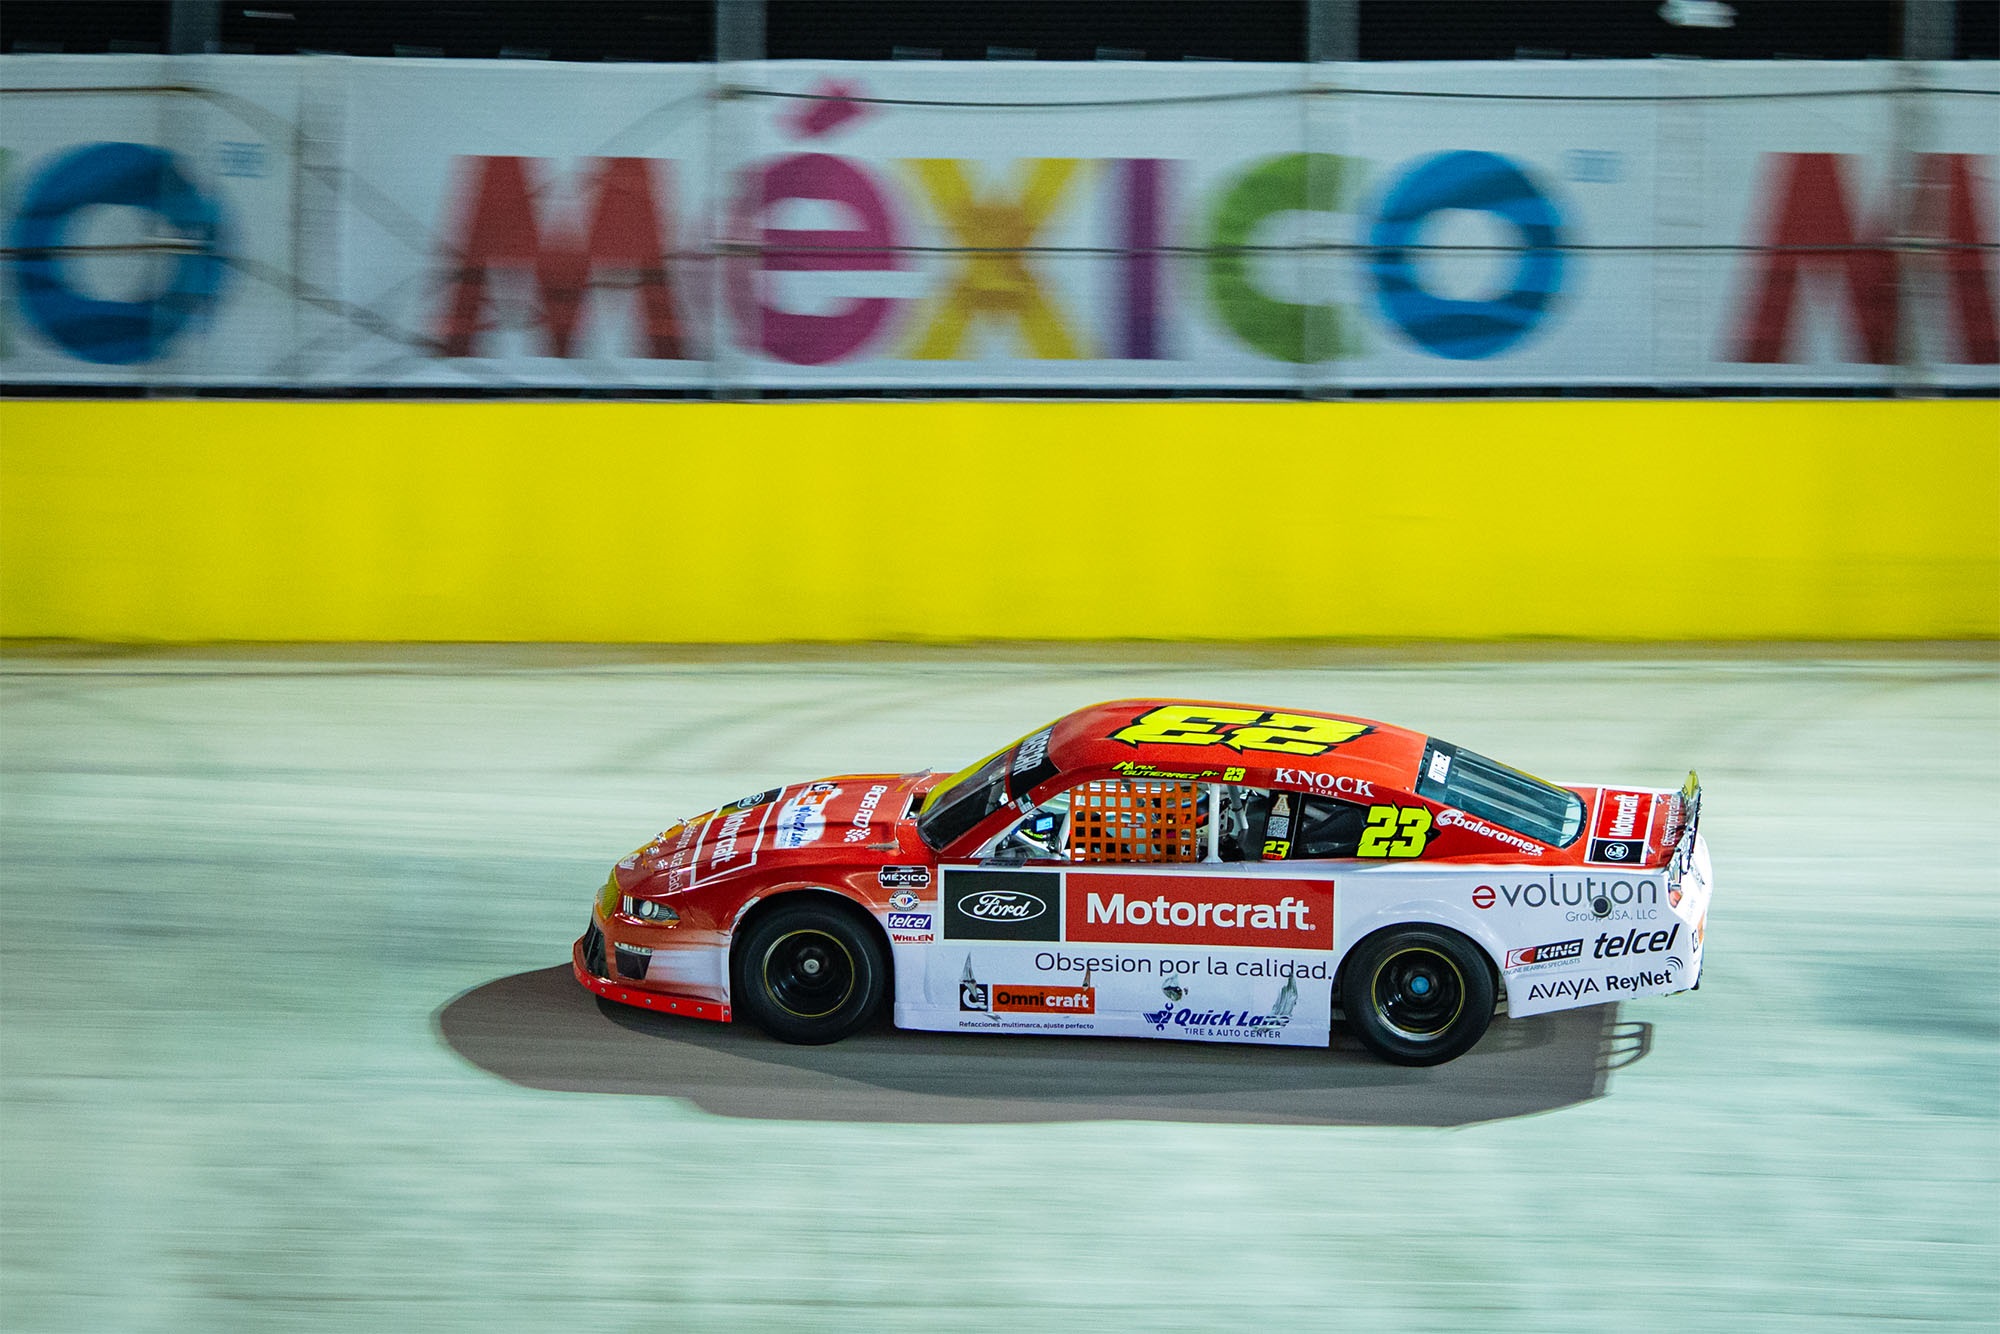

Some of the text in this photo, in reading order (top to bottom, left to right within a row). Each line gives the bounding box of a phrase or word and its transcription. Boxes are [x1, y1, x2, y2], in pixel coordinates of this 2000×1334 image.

[1222, 767, 1246, 781] 23
[1273, 767, 1375, 798] KNOCK
[1309, 786, 1338, 797] STORE
[1609, 794, 1639, 837] Motorcraft
[1357, 802, 1433, 858] 23
[1453, 814, 1546, 854] baleromex
[711, 809, 753, 870] Motorcraft
[1263, 841, 1290, 859] 23
[880, 873, 929, 882] MÉXICO
[1472, 873, 1657, 909] evolution
[974, 895, 1029, 917] Ford
[1637, 908, 1657, 920] LLC
[889, 915, 931, 928] telcel
[1594, 923, 1681, 960] telcel
[1536, 942, 1580, 960] KING
[1035, 952, 1332, 980] Obsesion por la calidad.
[1523, 961, 1548, 973] BEARING
[1528, 969, 1673, 1000] AVAYA ReyNet
[997, 991, 1089, 1009] Omnicraft
[1001, 1021, 1042, 1029] multimarca,
[1043, 1022, 1064, 1031] ajuste
[1065, 1022, 1095, 1030] perfecto
[1174, 1008, 1236, 1027] Quick
[1184, 1028, 1205, 1036] TIRE
[1216, 1029, 1241, 1037] AUTO
[1243, 1030, 1281, 1039] CENTER
